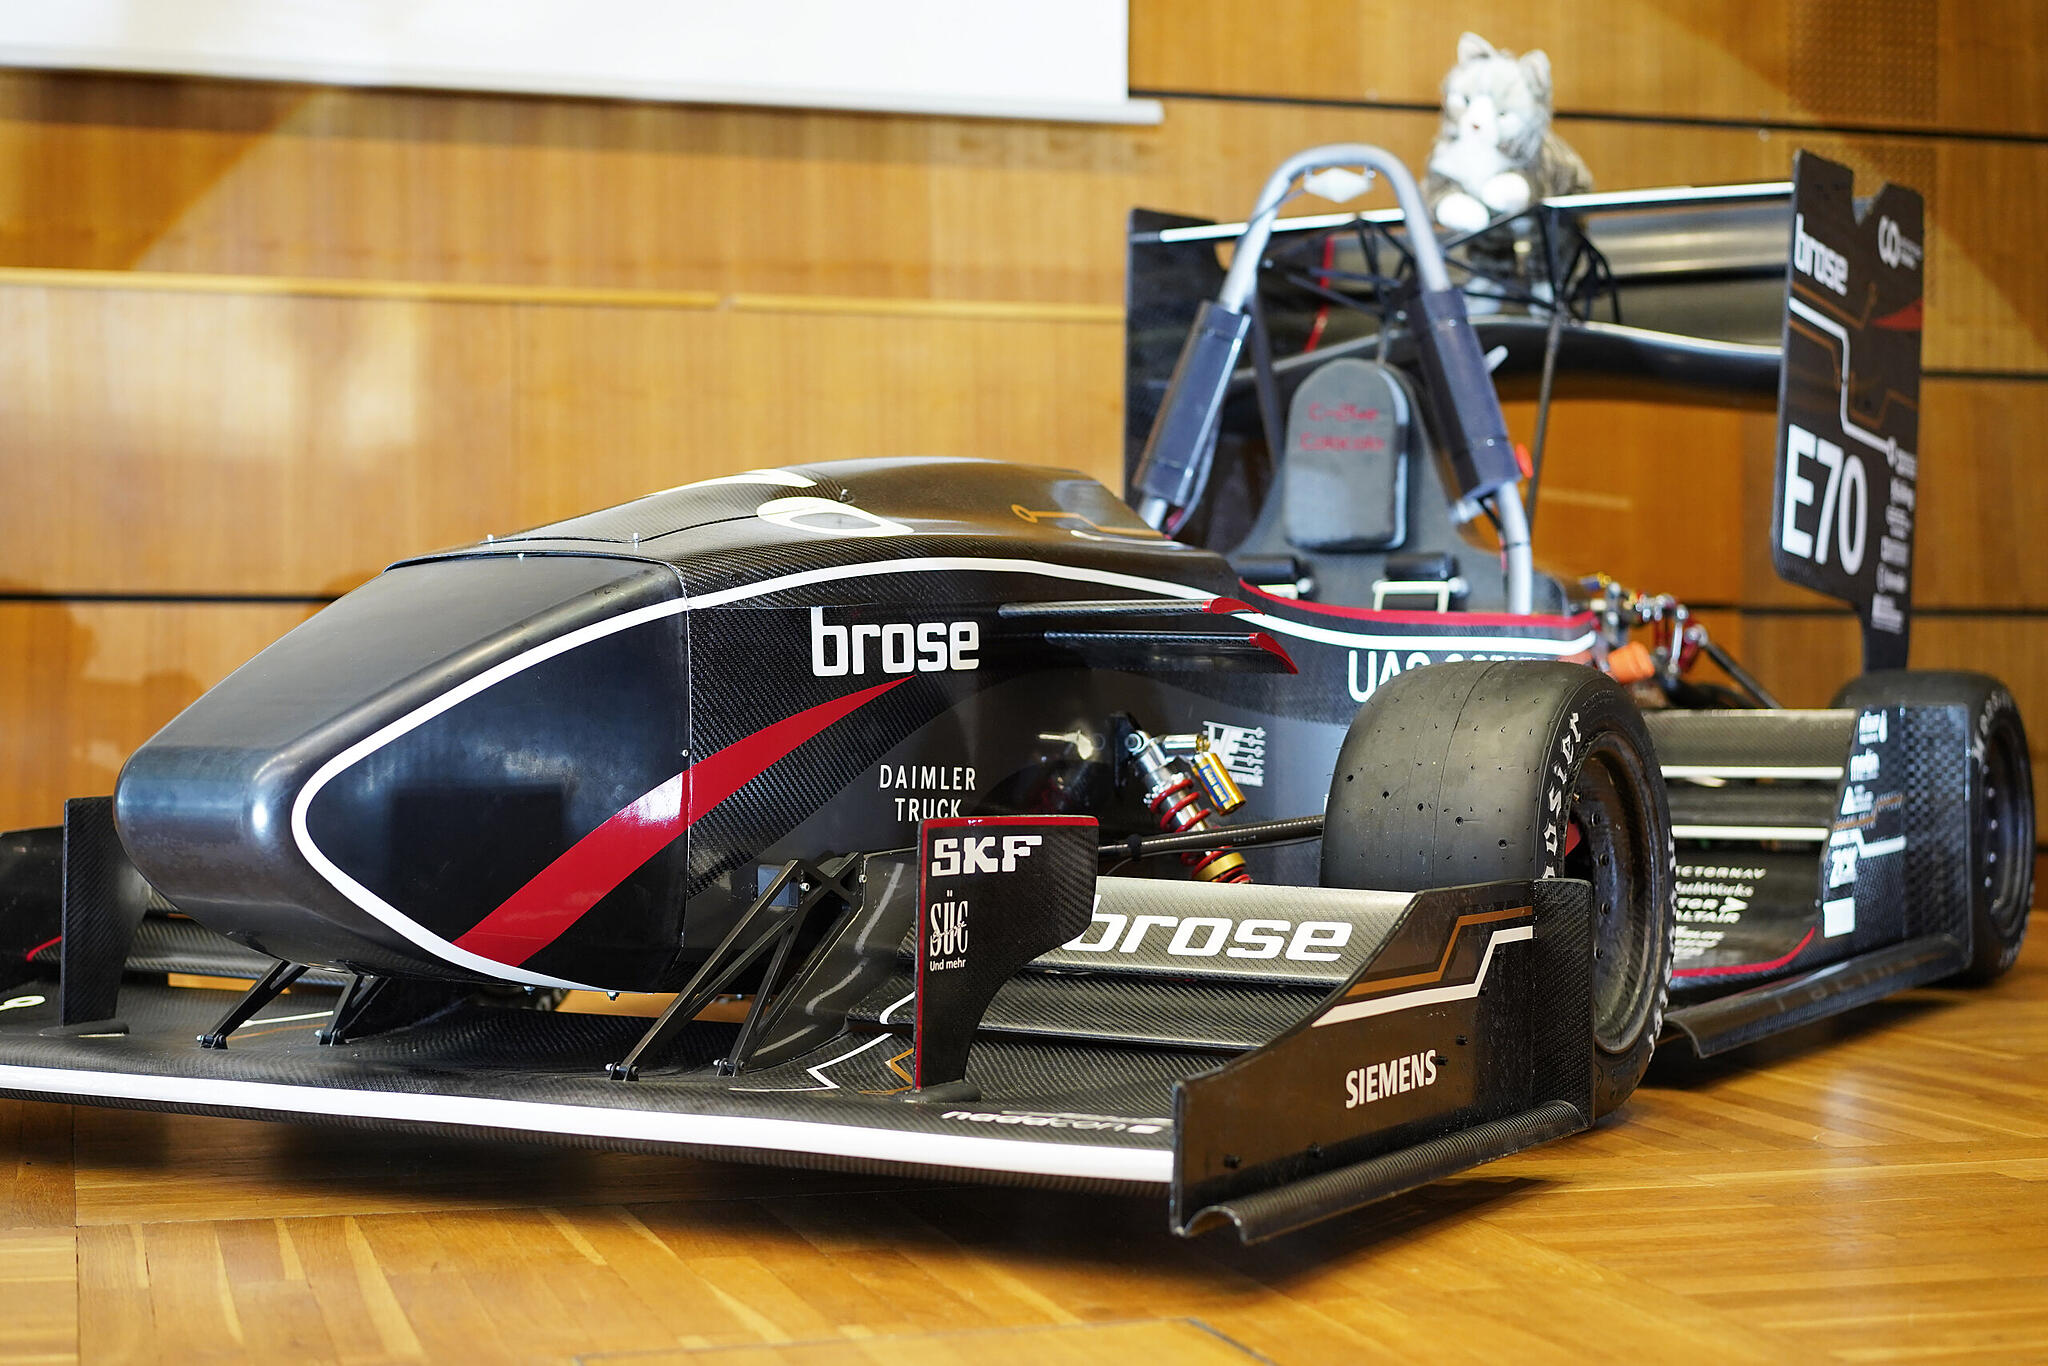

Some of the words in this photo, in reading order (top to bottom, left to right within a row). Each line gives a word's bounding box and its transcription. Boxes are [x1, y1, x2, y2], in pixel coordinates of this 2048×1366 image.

[1794, 212, 1849, 297] brose
[1782, 423, 1868, 576] E70
[810, 606, 980, 677] brose
[879, 764, 976, 791] DAIMLER
[894, 797, 962, 822] TRUCK
[931, 835, 1043, 877] SKF
[1061, 893, 1354, 963] brose
[929, 959, 945, 972] Und
[945, 956, 967, 970] mehr
[1345, 1049, 1438, 1110] SIEMENS
